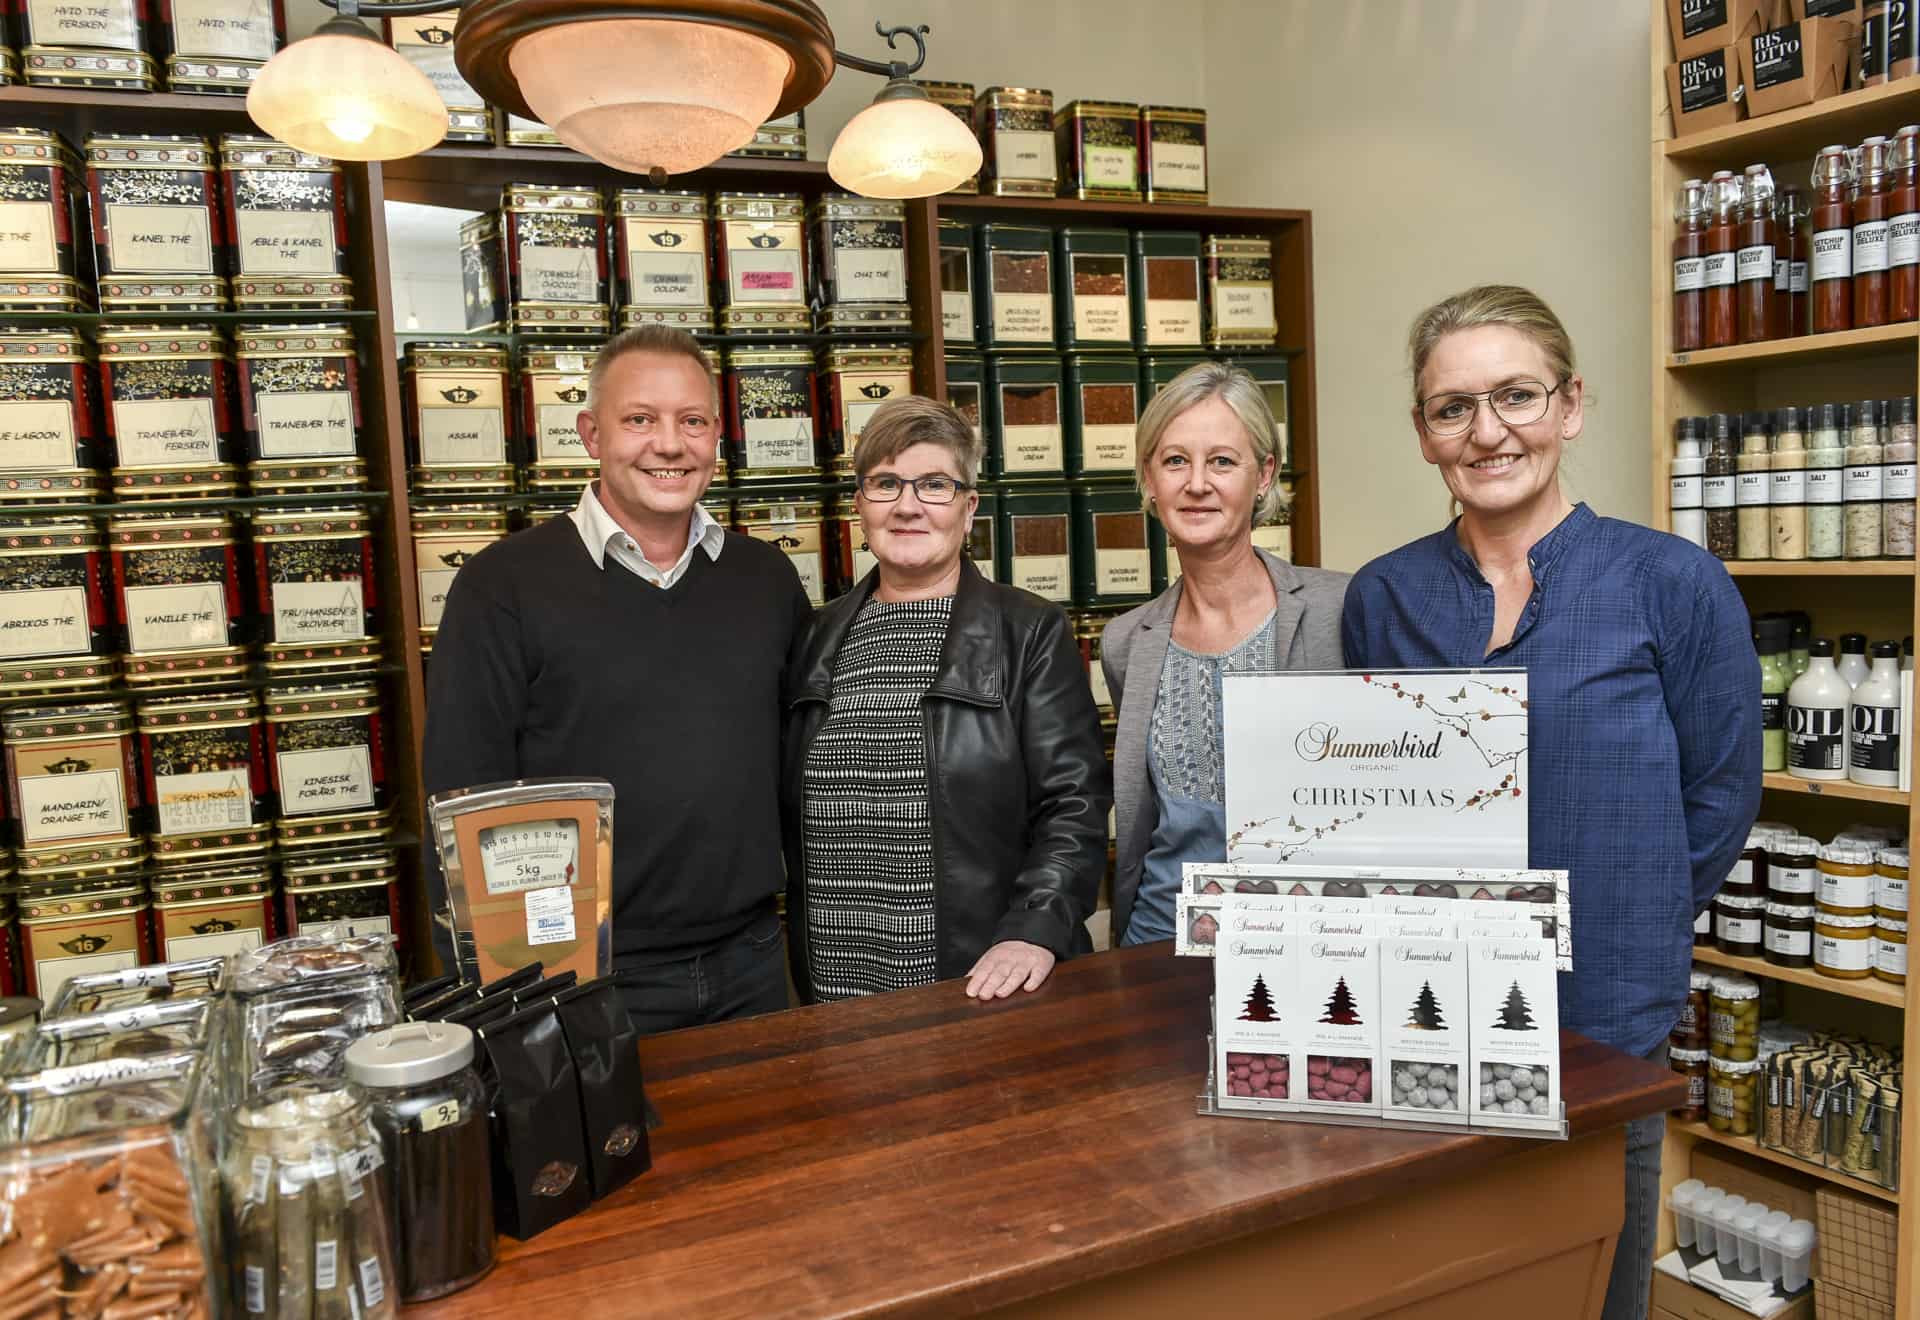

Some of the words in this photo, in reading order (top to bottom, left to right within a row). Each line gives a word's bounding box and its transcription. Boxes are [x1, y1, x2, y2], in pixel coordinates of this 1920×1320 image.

[54, 7, 84, 17] HVID
[87, 7, 109, 17] THE
[58, 19, 107, 30] FERSKEN
[199, 18, 226, 29] HVID
[230, 20, 251, 31] THE
[429, 30, 444, 43] 15
[1755, 32, 1781, 51] RIS
[1755, 39, 1800, 63] OTTO
[1682, 57, 1707, 76] RIS
[1682, 65, 1724, 87] OTTO
[9, 232, 32, 242] THE
[1856, 228, 1887, 239] KETCHUP
[1890, 228, 1920, 239] DELUXE
[131, 234, 166, 245] KANEL
[169, 234, 192, 245] THE
[251, 237, 280, 248] ÆBLE
[290, 238, 324, 248] KANEL
[658, 235, 675, 247] 19
[760, 237, 770, 248] 6
[1857, 235, 1884, 246] DELUXE
[279, 249, 300, 260] THE
[1815, 244, 1842, 254] DELUXE
[876, 270, 889, 279] THE
[453, 391, 468, 402] 12
[870, 386, 881, 398] 11
[268, 419, 324, 430] TRANEBÆR
[326, 418, 347, 429] THE
[14, 430, 62, 441] LAGOON
[447, 432, 479, 441] ASSAM
[164, 440, 210, 452] FERSKEN
[1810, 473, 1826, 482] SALT
[1852, 470, 1870, 479] SALT
[1890, 468, 1909, 477] SALT
[1742, 476, 1758, 485] SALT
[1775, 474, 1791, 483] SALT
[1673, 480, 1687, 489] SALT
[779, 539, 793, 551] 10
[1, 618, 51, 630] ABRIKOS
[53, 616, 76, 627] THE
[144, 612, 190, 625] VANILLE
[191, 611, 214, 622] THE
[1788, 707, 1843, 736] OIL
[1294, 721, 1444, 763] Summerbird
[1349, 763, 1400, 772] ORGANIC
[303, 775, 351, 787] KINESISK
[340, 784, 359, 795] THE
[1293, 786, 1456, 808] CHRISTMAS
[41, 812, 85, 826] ORANGE
[88, 809, 110, 822] THE
[1785, 871, 1800, 879] JAM
[1823, 877, 1838, 886] JAM
[1887, 881, 1904, 890] JAM
[1728, 920, 1742, 928] JAM
[1776, 931, 1791, 940] JAM
[74, 939, 94, 953] 16
[1230, 939, 1286, 957] Summerbird
[1822, 940, 1837, 949] JAM
[1881, 943, 1896, 953] JAM
[1311, 942, 1367, 959] Summerbird
[1394, 943, 1453, 963] Summerbird
[1482, 944, 1542, 962] Summerbird
